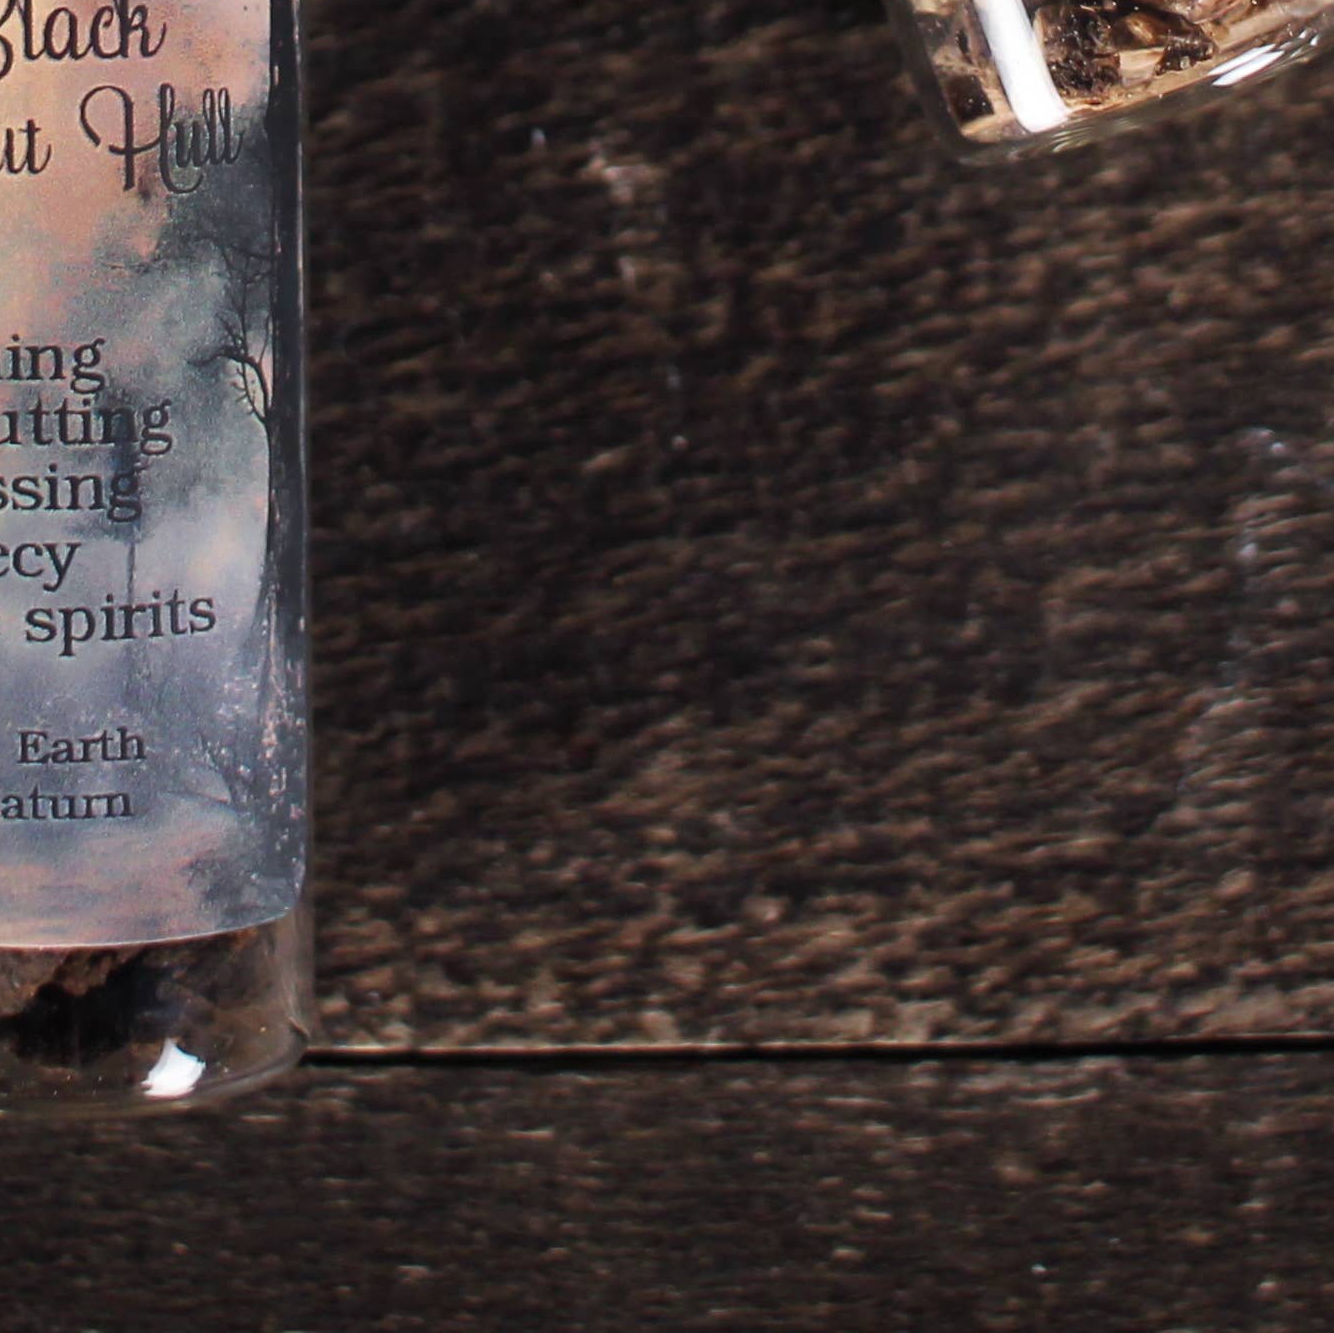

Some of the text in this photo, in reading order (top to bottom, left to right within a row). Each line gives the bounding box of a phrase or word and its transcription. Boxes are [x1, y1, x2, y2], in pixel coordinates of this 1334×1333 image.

[80, 83, 243, 194] Hull
[26, 589, 217, 657] spirits
[17, 726, 147, 765] Earth
